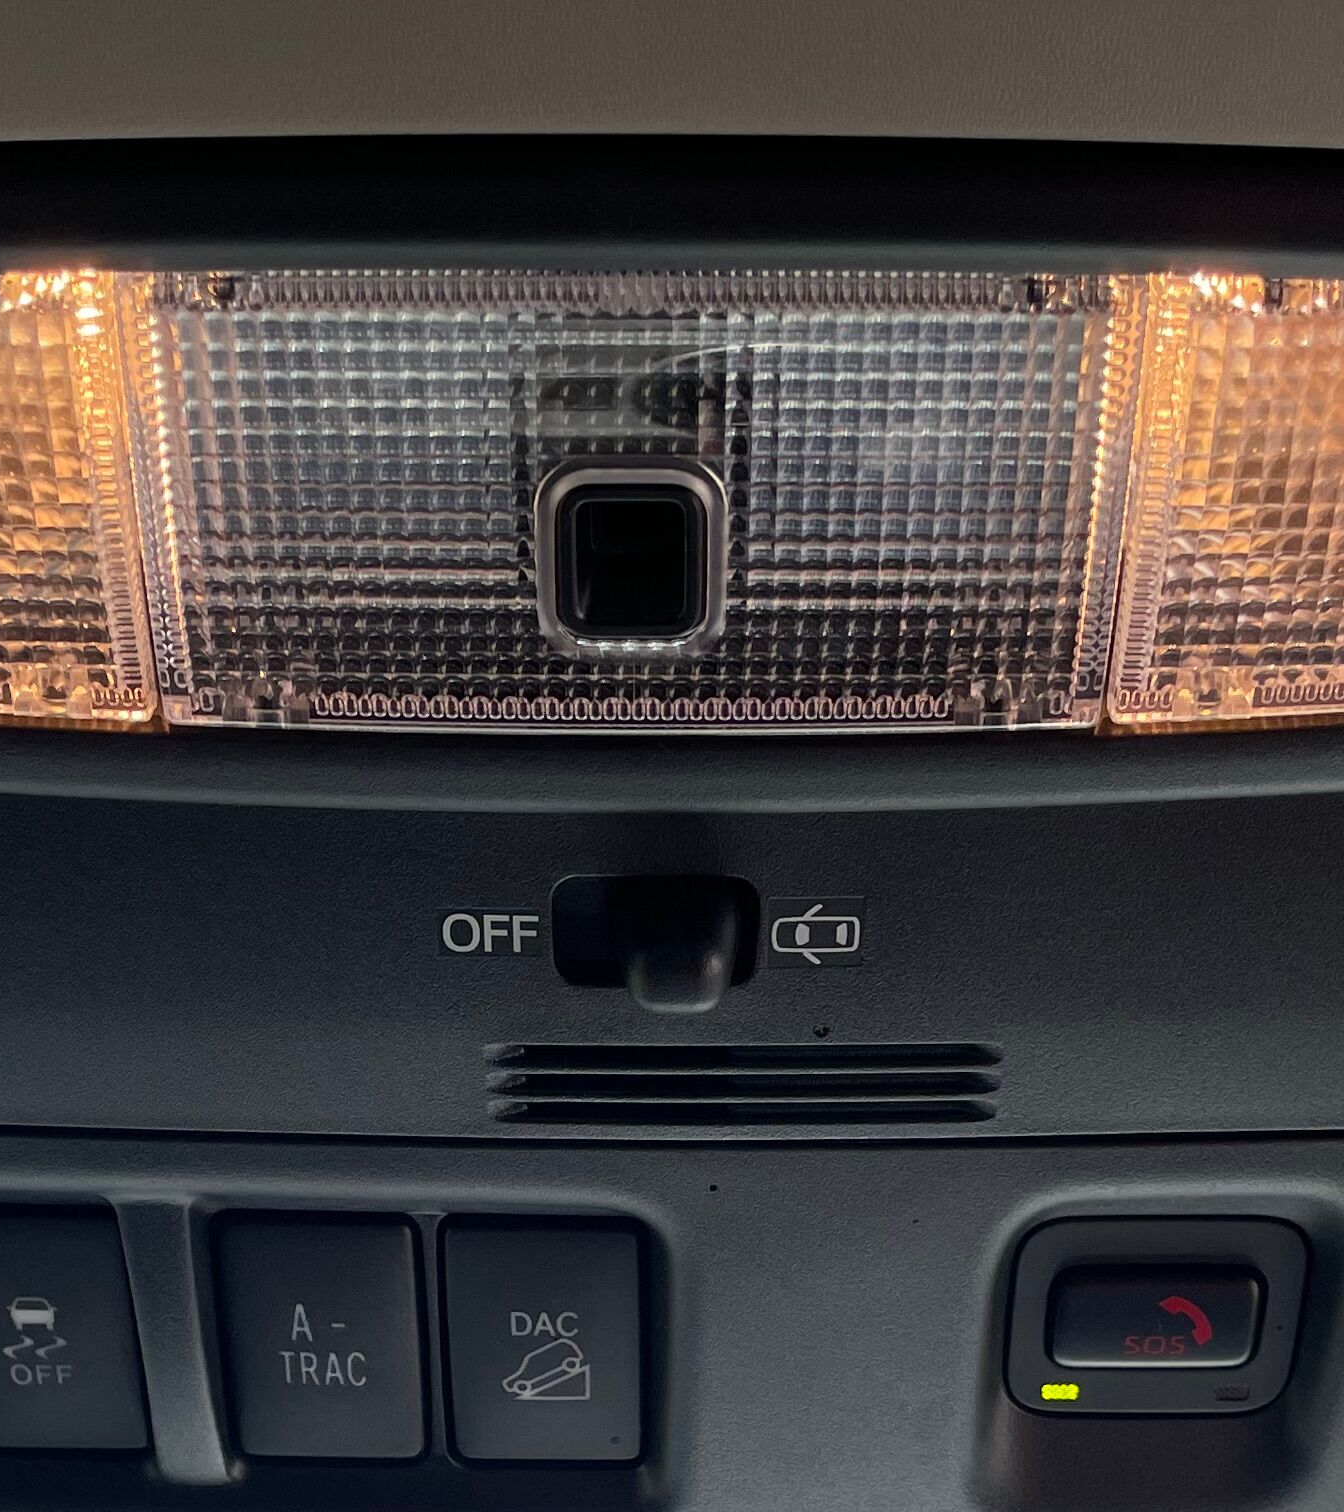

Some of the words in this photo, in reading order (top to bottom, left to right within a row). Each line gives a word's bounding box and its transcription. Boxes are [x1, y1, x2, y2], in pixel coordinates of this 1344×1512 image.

[442, 912, 540, 953] OFF
[291, 1304, 313, 1342] A
[510, 1311, 580, 1338] DAC
[1123, 1335, 1185, 1355] SOS
[10, 1363, 73, 1386] OFF
[280, 1351, 367, 1388] TRAC
